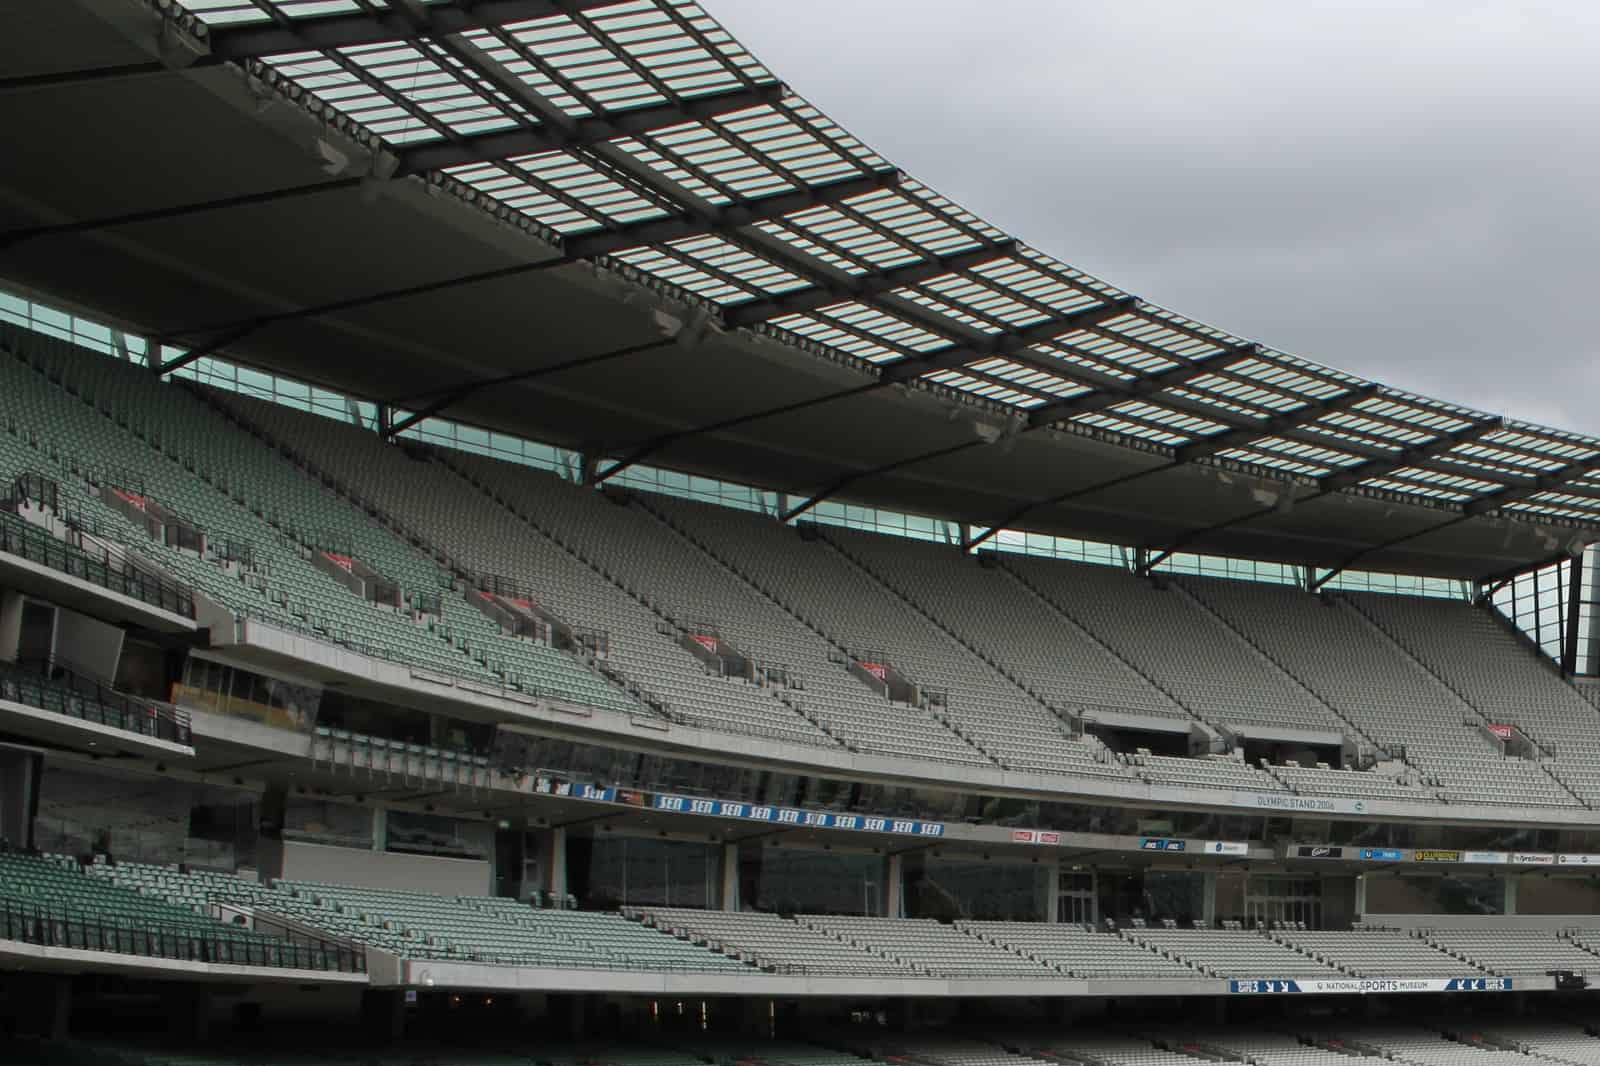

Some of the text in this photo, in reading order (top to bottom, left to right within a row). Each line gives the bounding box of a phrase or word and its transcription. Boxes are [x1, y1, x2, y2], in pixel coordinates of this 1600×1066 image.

[1257, 796, 1288, 808] OLYMPIC
[1290, 798, 1316, 809] STAND
[1326, 982, 1358, 990] NATIONAL
[1360, 980, 1398, 991] SPORTS
